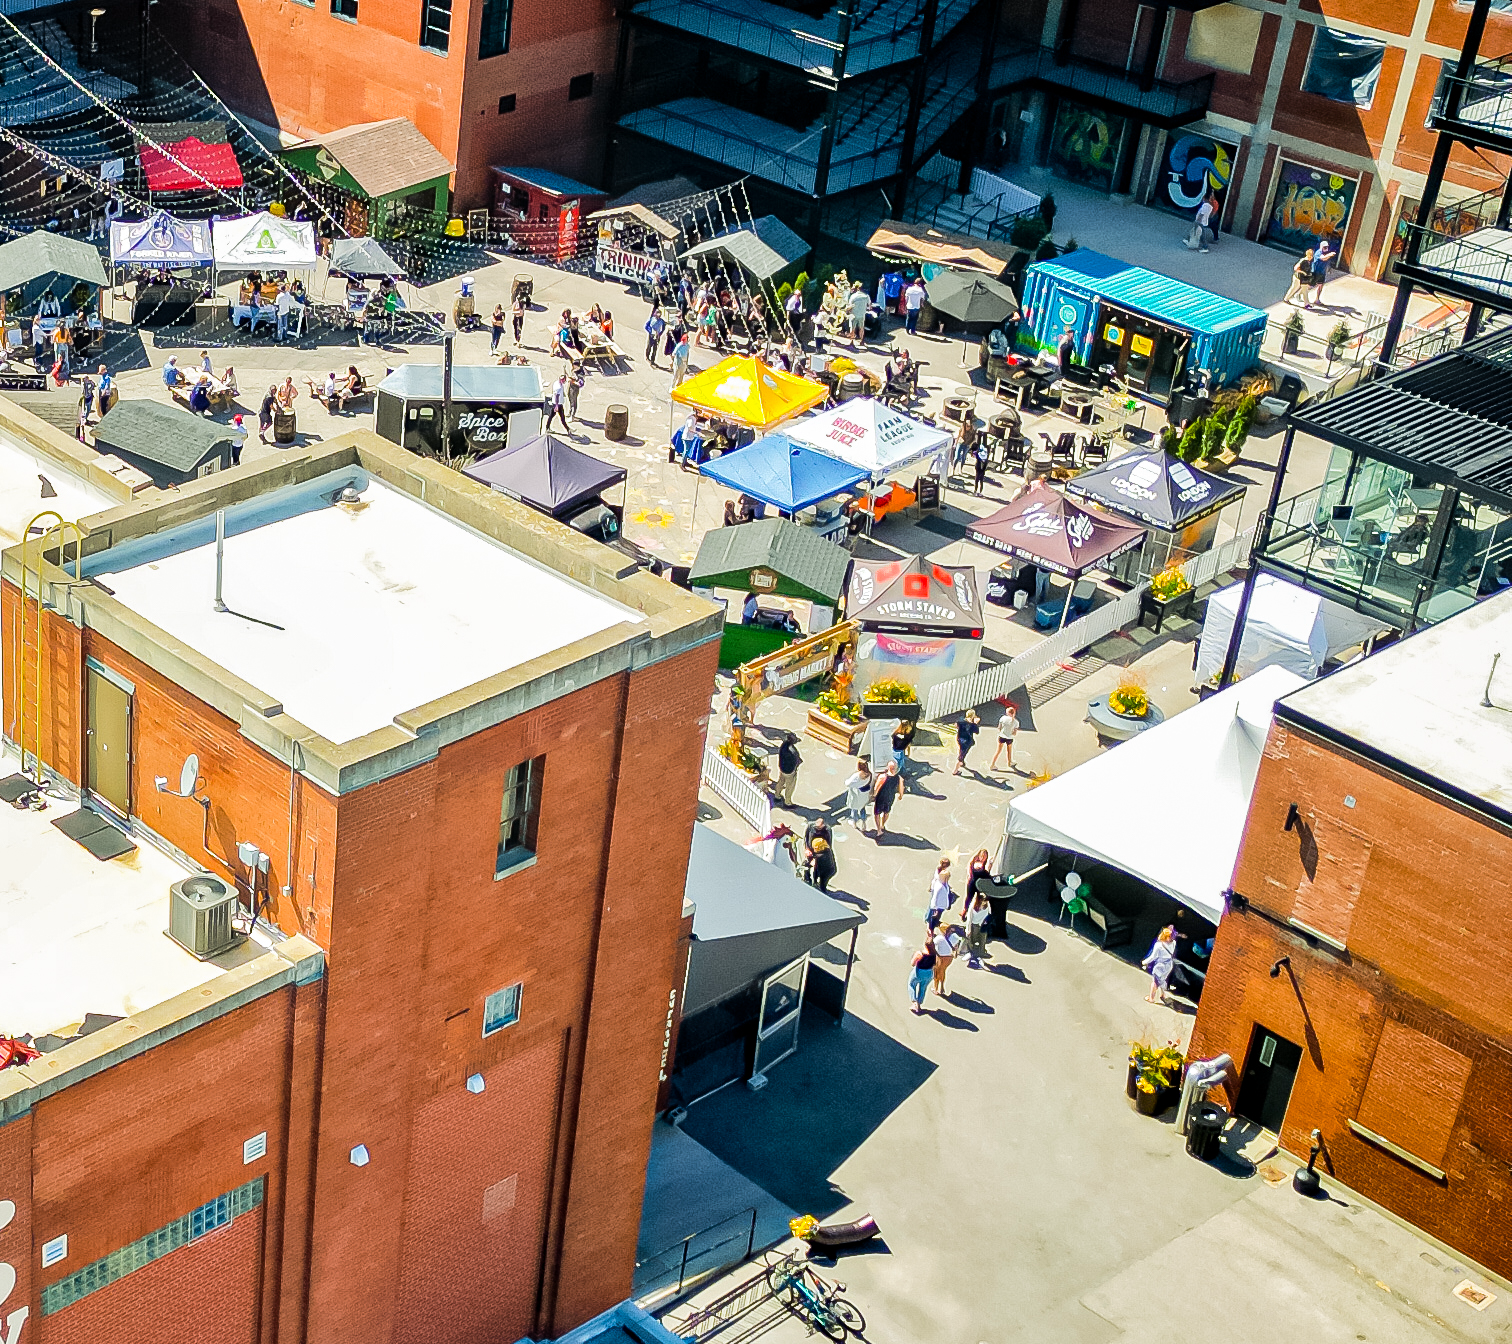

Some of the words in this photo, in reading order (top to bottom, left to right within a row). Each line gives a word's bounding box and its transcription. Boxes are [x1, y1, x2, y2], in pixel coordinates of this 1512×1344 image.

[603, 262, 647, 281] KITCH
[458, 412, 505, 429] Spice
[877, 416, 902, 432] FARM
[472, 427, 508, 442] Box
[879, 423, 914, 443] LEAGUE
[1110, 476, 1158, 501] LONDON
[1177, 480, 1212, 502] LONDON
[876, 600, 916, 616] STORM
[916, 600, 957, 620] STAYED
